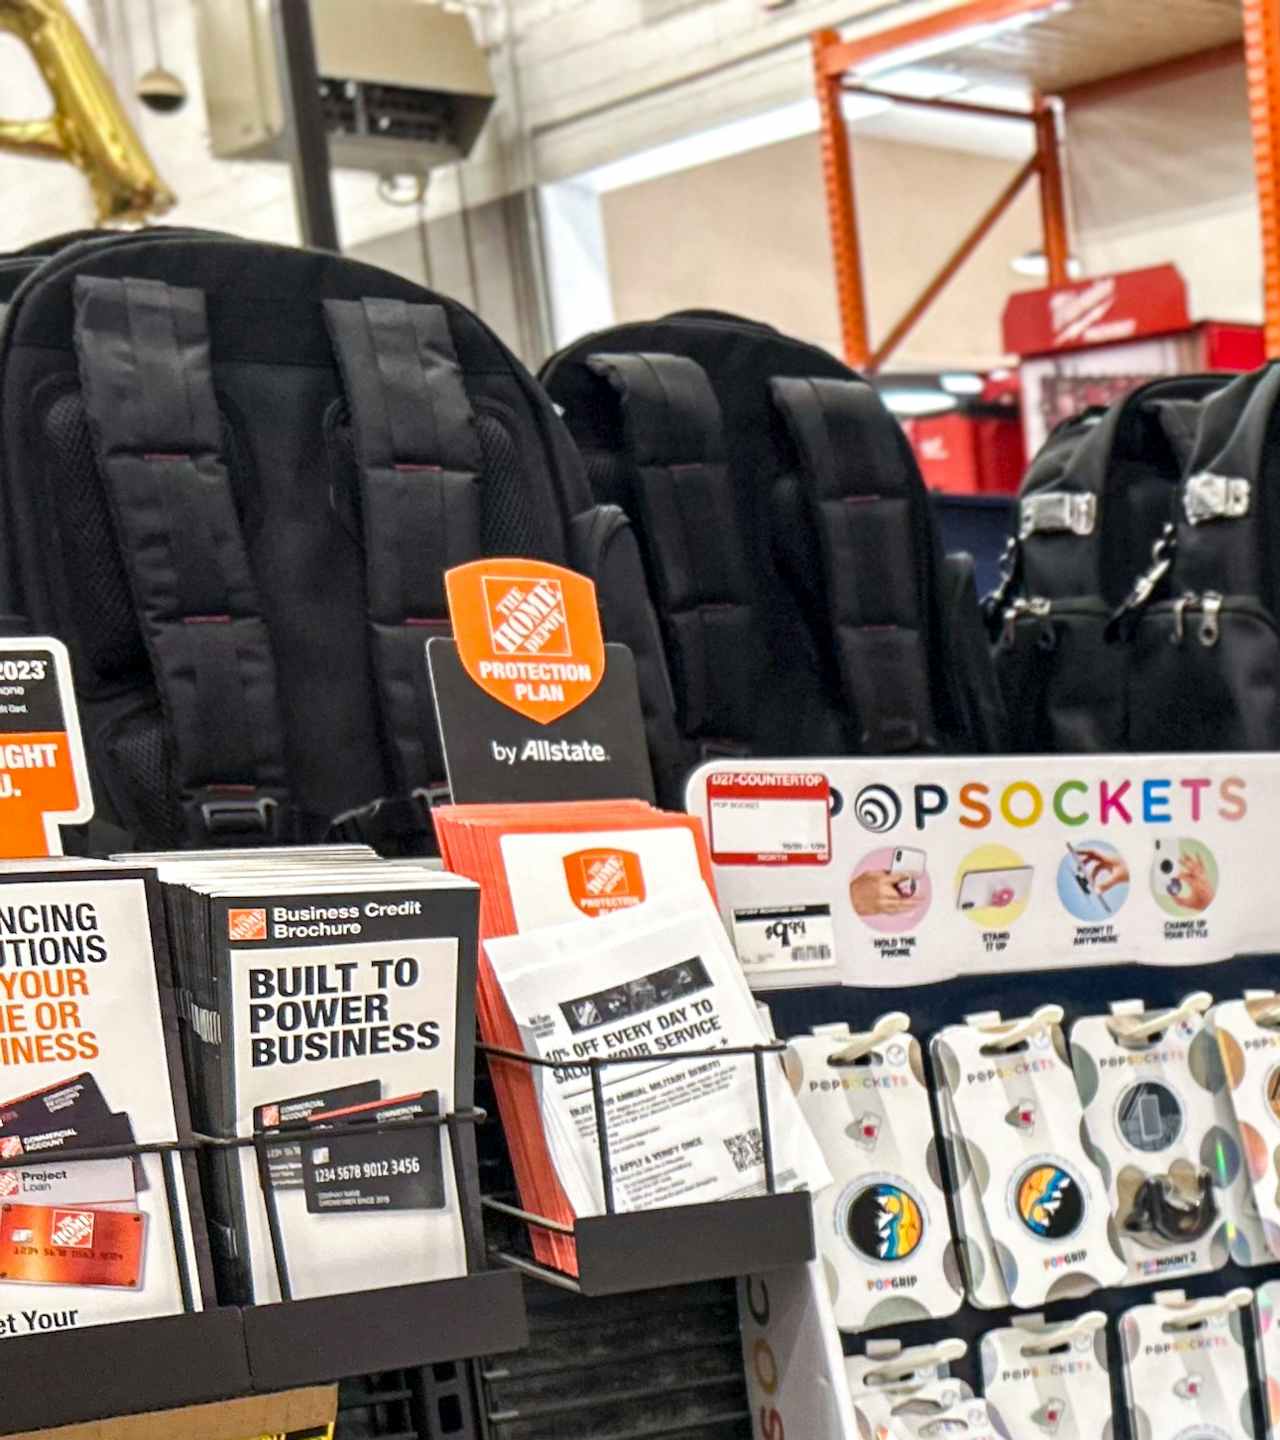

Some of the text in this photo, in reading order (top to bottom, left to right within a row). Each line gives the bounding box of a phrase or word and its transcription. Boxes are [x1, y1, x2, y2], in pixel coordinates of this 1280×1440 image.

[493, 579, 562, 653] HOME
[479, 660, 592, 682] PROTECTION
[514, 683, 565, 702] PLAN
[492, 739, 606, 765] by Allstate
[273, 900, 423, 923] Business Credit
[273, 922, 362, 939] Brochure
[899, 937, 917, 947] THE
[982, 932, 1011, 943] STAND
[0, 968, 89, 1000] YOUR
[249, 957, 420, 999] BUILT TO
[35, 1001, 81, 1031] OR
[249, 993, 390, 1035] POWER
[572, 998, 714, 1058] OFF EVERY DAY TO
[653, 1015, 722, 1050] SERVICE
[251, 1021, 441, 1068] BUSINESS
[21, 1170, 68, 1182] Project
[315, 1156, 421, 1183] 1234 5678 9012 3456
[23, 1183, 52, 1193] Loan
[867, 1275, 918, 1291] POPGRIP
[22, 1308, 79, 1331] Your
